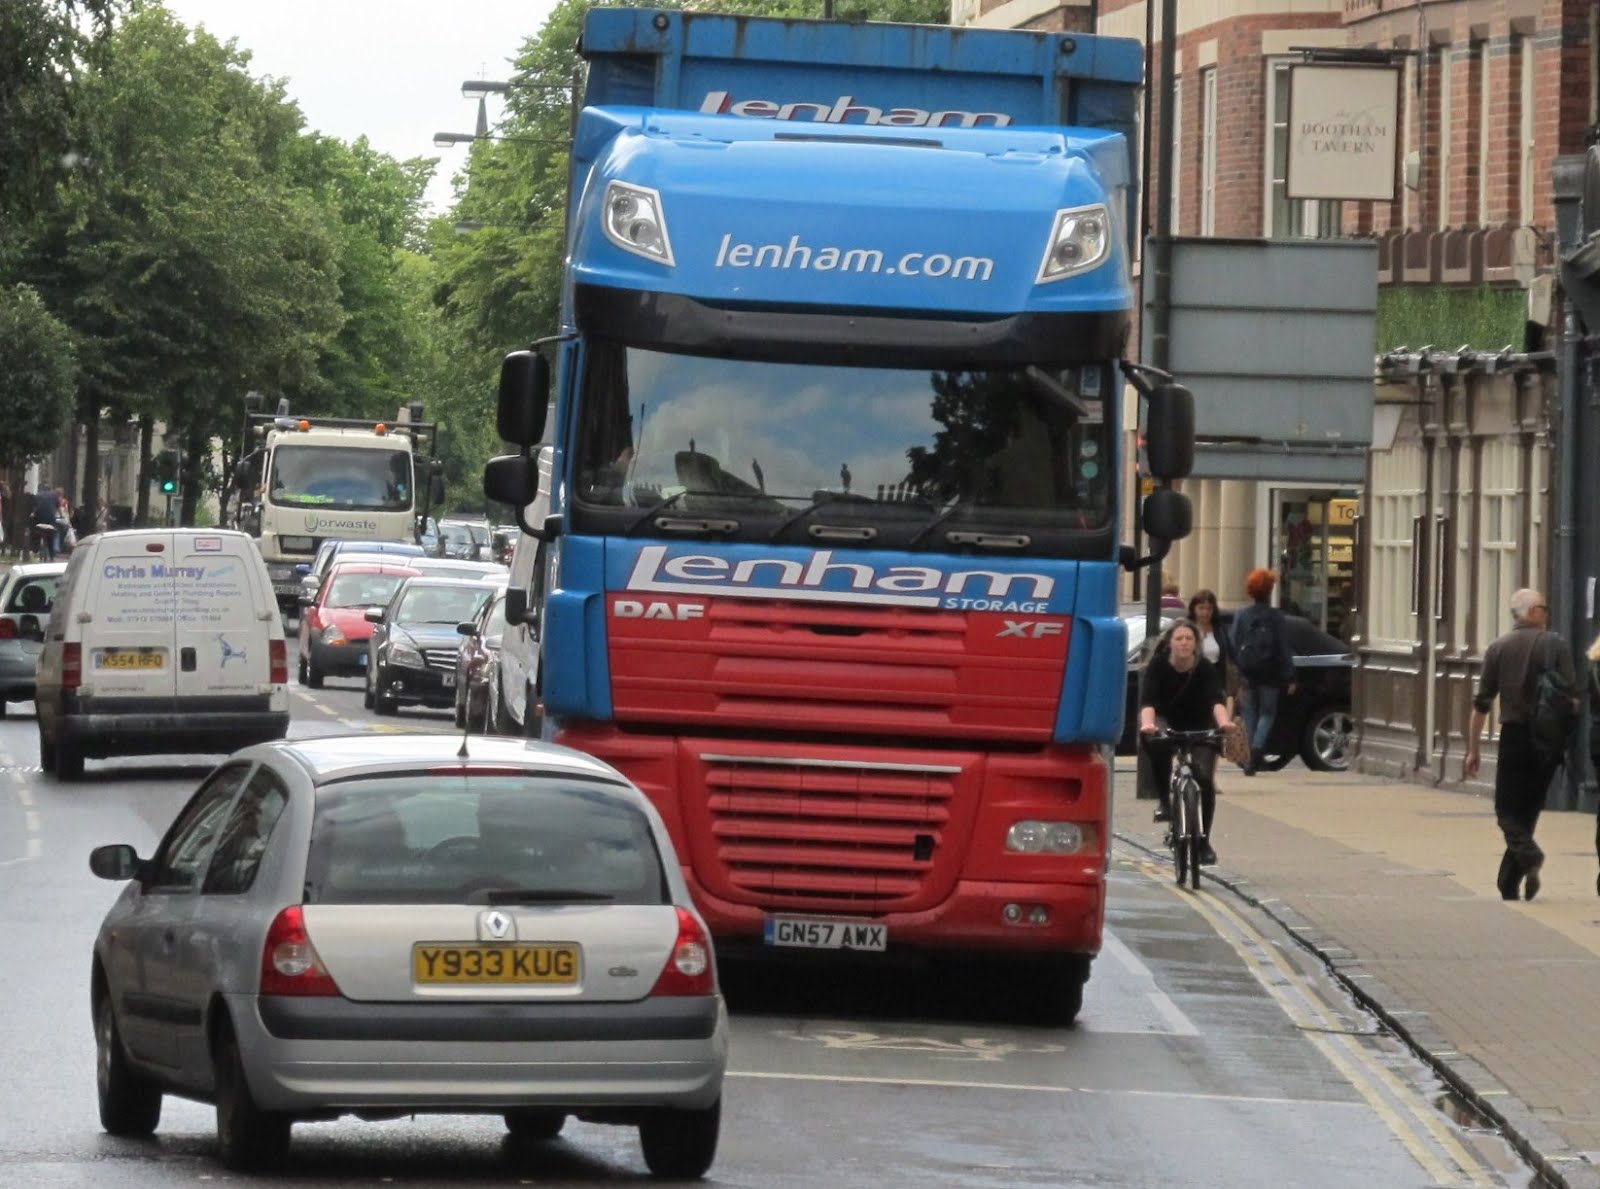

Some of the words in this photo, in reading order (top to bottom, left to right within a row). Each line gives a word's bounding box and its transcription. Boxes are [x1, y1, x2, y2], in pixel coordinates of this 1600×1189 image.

[1302, 123, 1386, 137] BOOTHAM
[1312, 140, 1375, 153] TAVERN
[715, 233, 994, 281] lenham.com
[104, 565, 146, 579] Chris
[151, 564, 206, 580] Murray
[627, 545, 1056, 607] Lenham
[613, 600, 704, 621] DAF
[944, 597, 1049, 614] STORAGE
[996, 620, 1066, 639] XF
[778, 922, 834, 944] GN57
[841, 926, 882, 947] AWX
[421, 950, 504, 977] Y933
[512, 949, 573, 977] KUG
